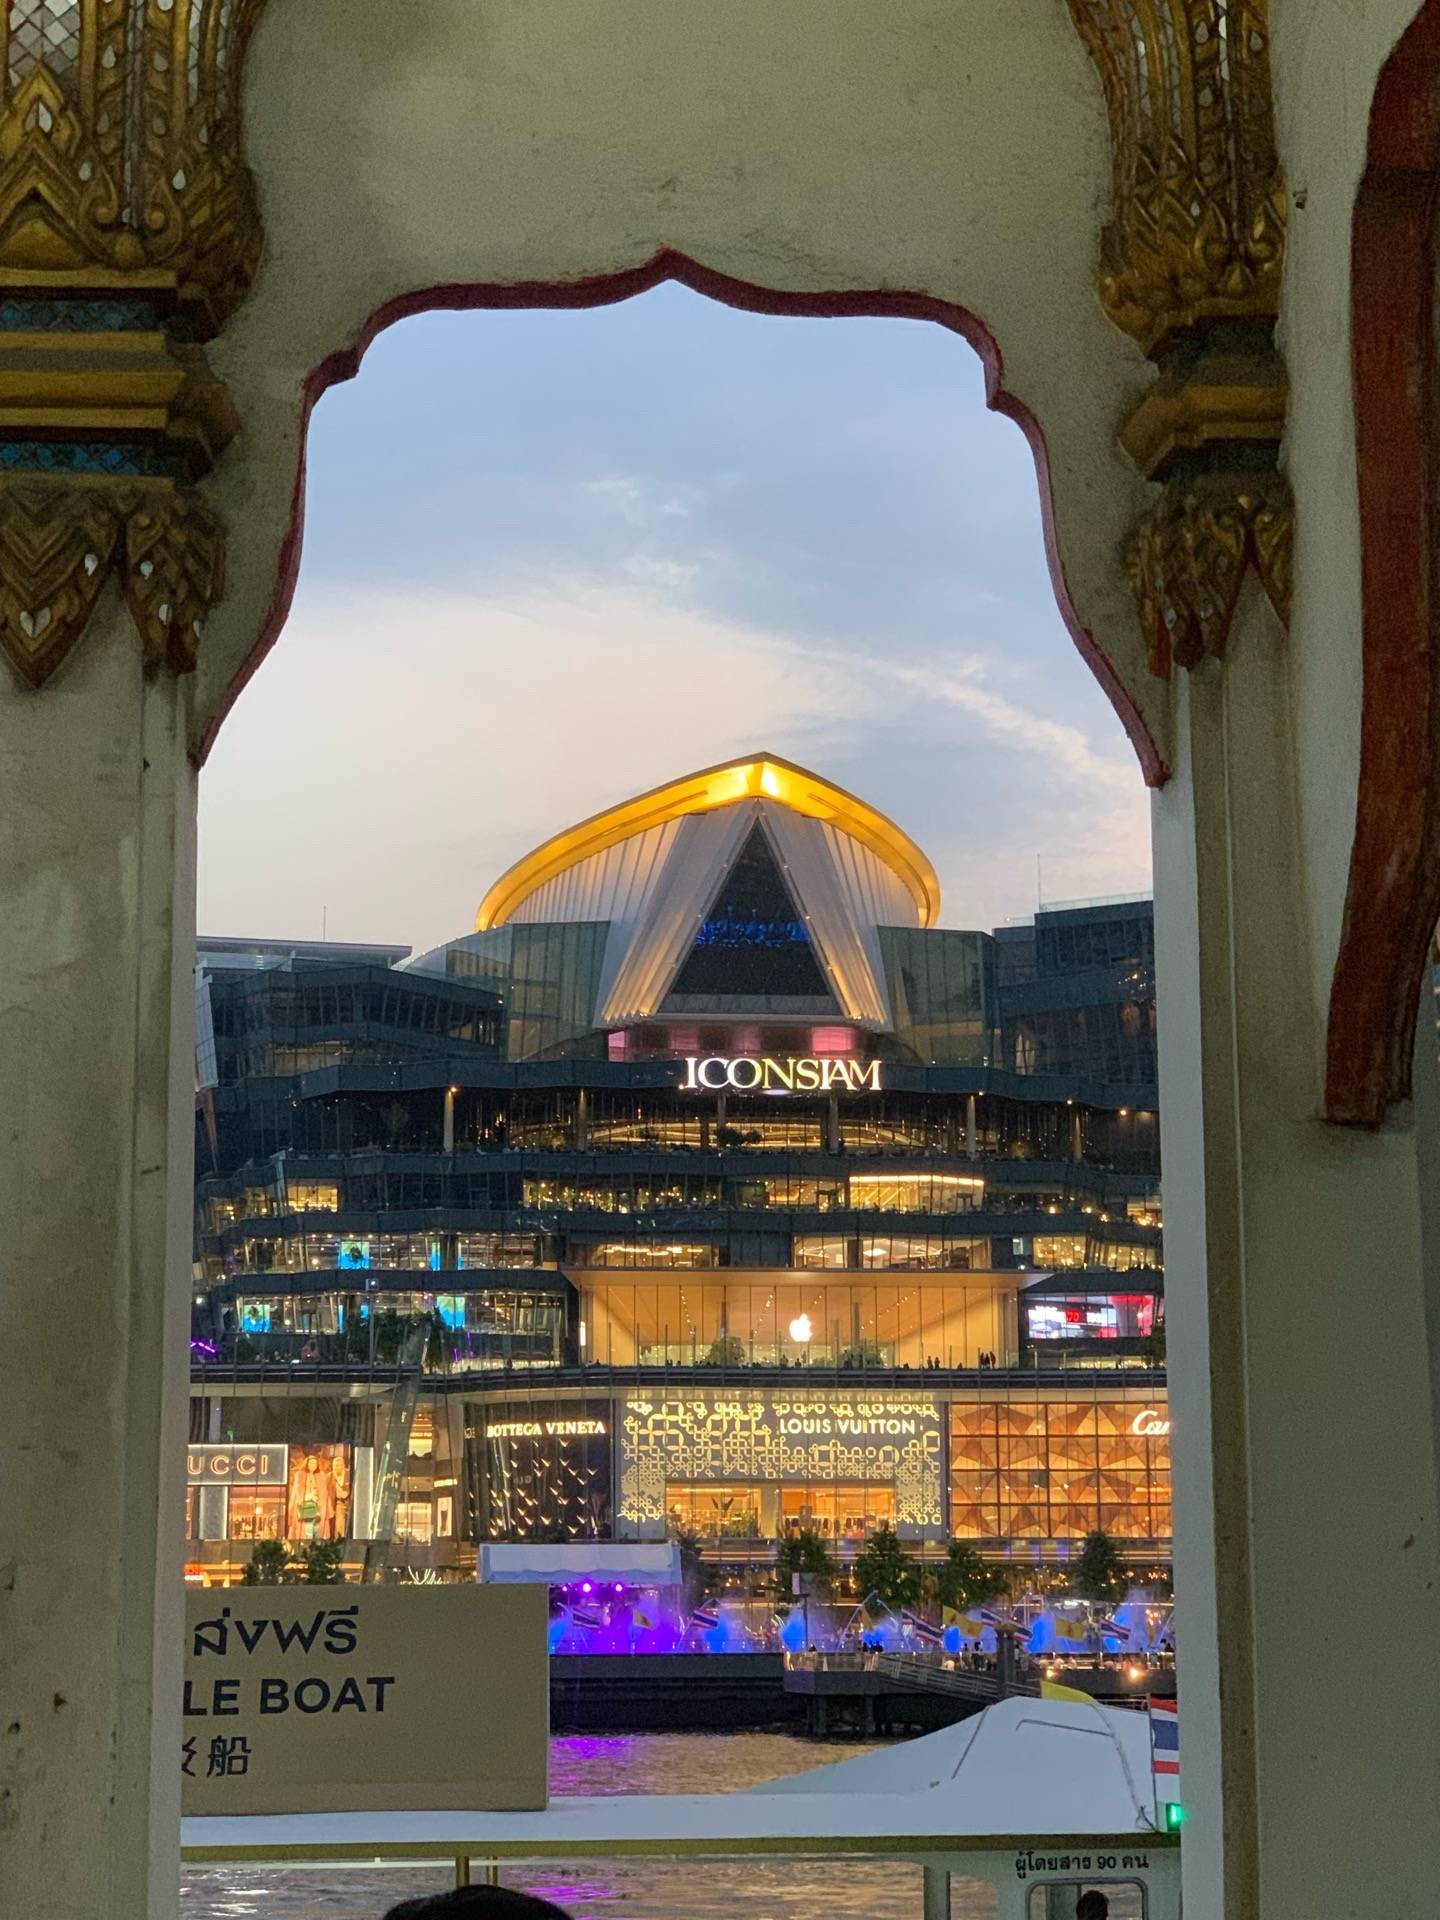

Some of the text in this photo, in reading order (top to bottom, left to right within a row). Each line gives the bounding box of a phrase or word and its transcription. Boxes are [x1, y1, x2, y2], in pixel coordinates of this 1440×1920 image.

[684, 1057, 882, 1091] ICONSIAM
[487, 1421, 606, 1437] BOTTEGA VENETA
[780, 1418, 915, 1434] LOUIS VUITTON
[183, 1677, 395, 1716] LE BOAT
[1015, 1851, 1149, 1879] ผู้โดยสาร 90 คน
